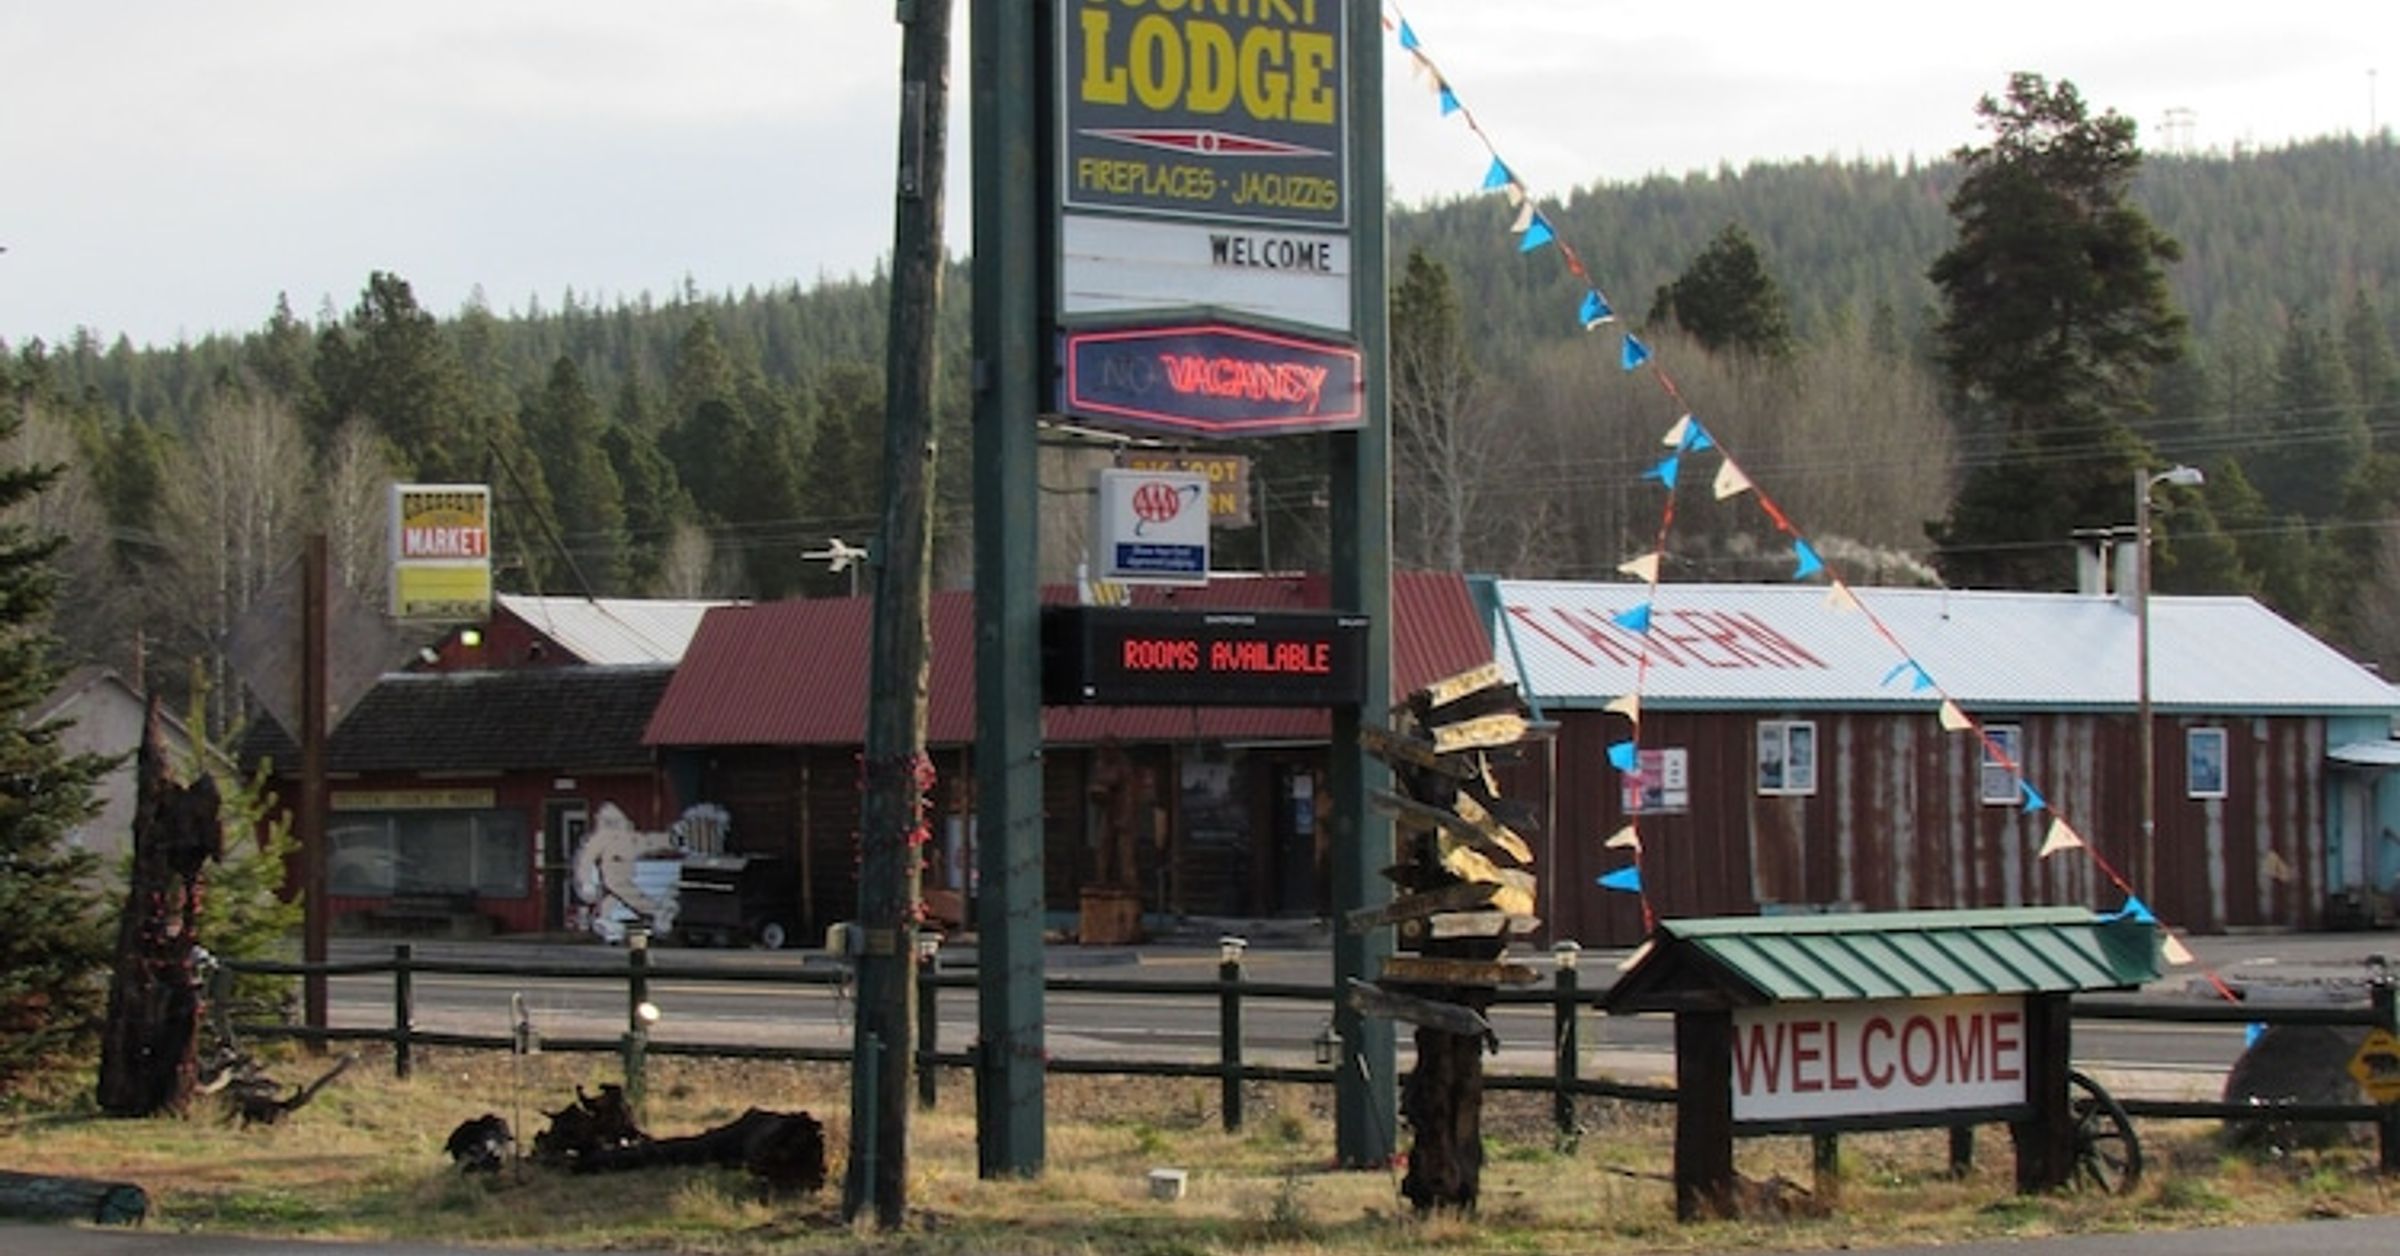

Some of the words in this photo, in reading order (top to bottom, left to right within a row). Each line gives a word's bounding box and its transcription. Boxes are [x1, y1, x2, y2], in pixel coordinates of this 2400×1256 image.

[1080, 9, 1334, 124] LODGE
[1078, 158, 1215, 200] FIREPLACES
[1231, 172, 1337, 210] JACUZZIS
[1209, 234, 1333, 272] WELCOME
[1161, 355, 1328, 414] VACANCY
[1134, 482, 1181, 522] AAA
[406, 527, 483, 555] MARKET
[1124, 640, 1198, 669] ROOMS
[1210, 642, 1330, 672] AVAILABLE
[1732, 1012, 2021, 1096] WELCOME
